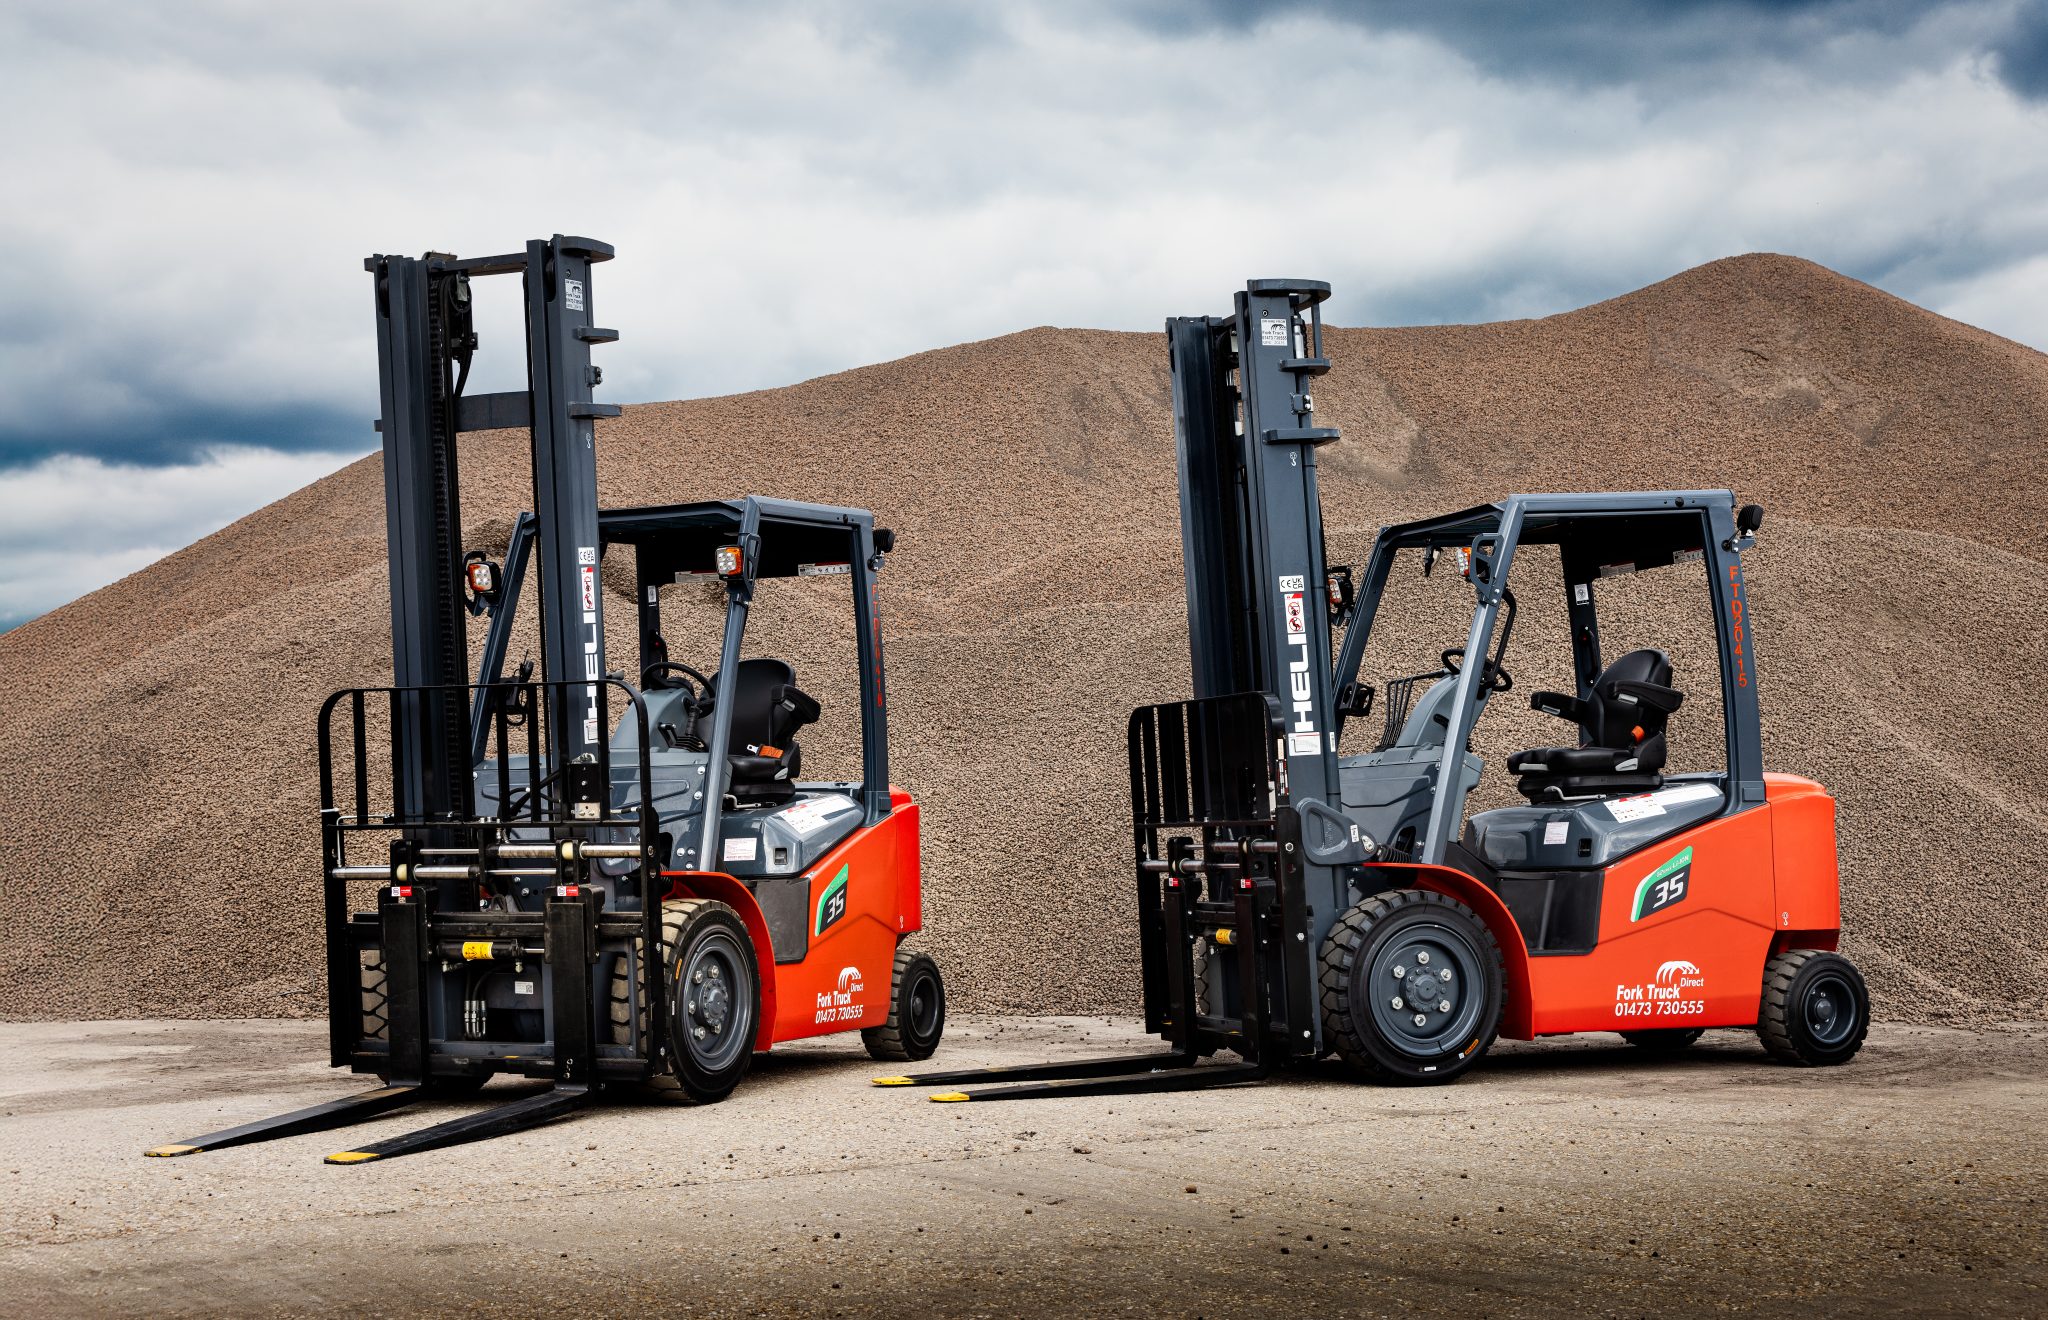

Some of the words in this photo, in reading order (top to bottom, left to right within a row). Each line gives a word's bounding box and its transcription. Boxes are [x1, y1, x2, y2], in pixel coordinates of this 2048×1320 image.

[1280, 579, 1291, 589] CE
[1729, 565, 1748, 688] FTD20415
[1287, 633, 1315, 733] HELI
[1653, 872, 1685, 909] 35
[826, 889, 845, 924] 35
[850, 982, 864, 992] Direct
[1616, 984, 1643, 1001] Fork
[1647, 983, 1680, 1000] Truck
[1680, 977, 1704, 987] Direct
[816, 992, 832, 1009] Fork
[833, 989, 851, 1006] Truck
[1615, 1001, 1652, 1017] 01473
[1656, 1000, 1704, 1015] 730555
[815, 1008, 836, 1024] 01473
[837, 1004, 864, 1020] 730555
